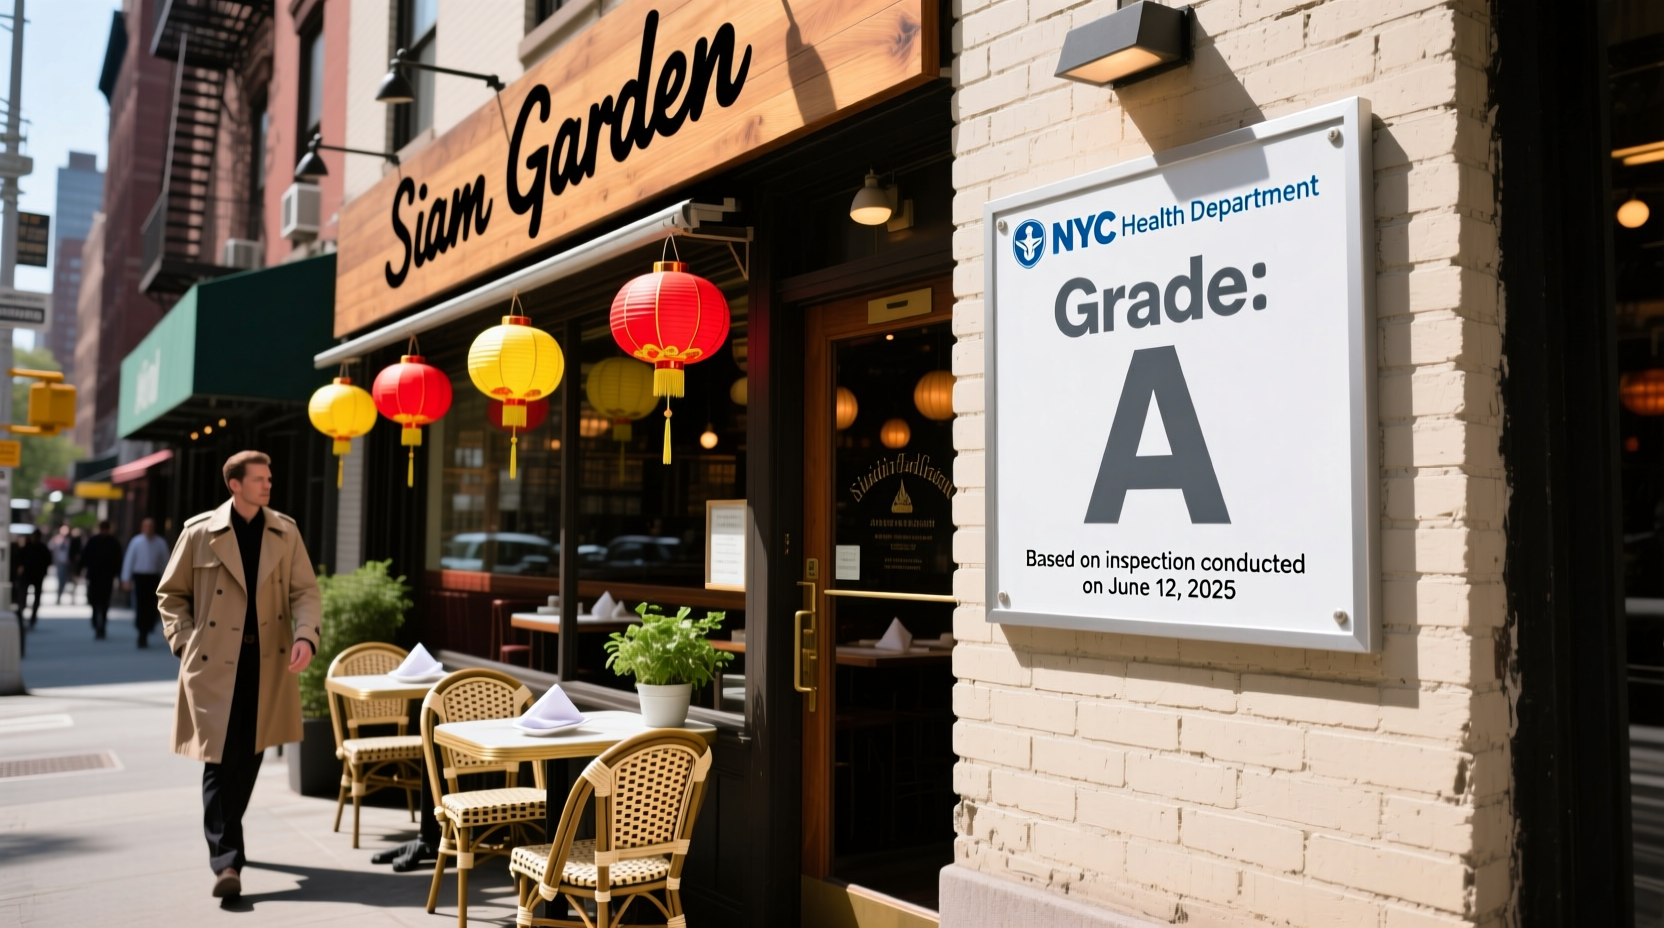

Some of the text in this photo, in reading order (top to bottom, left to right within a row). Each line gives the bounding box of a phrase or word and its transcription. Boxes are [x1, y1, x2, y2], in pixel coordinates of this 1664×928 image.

[385, 9, 752, 289] Siam Garden
[1052, 174, 1320, 255] NYC Health Department
[1054, 254, 1267, 338] Grade:
[1083, 344, 1232, 525] A
[1026, 549, 1305, 575] Based on inspection conducted
[1082, 576, 1237, 601] on June 12, 2025
